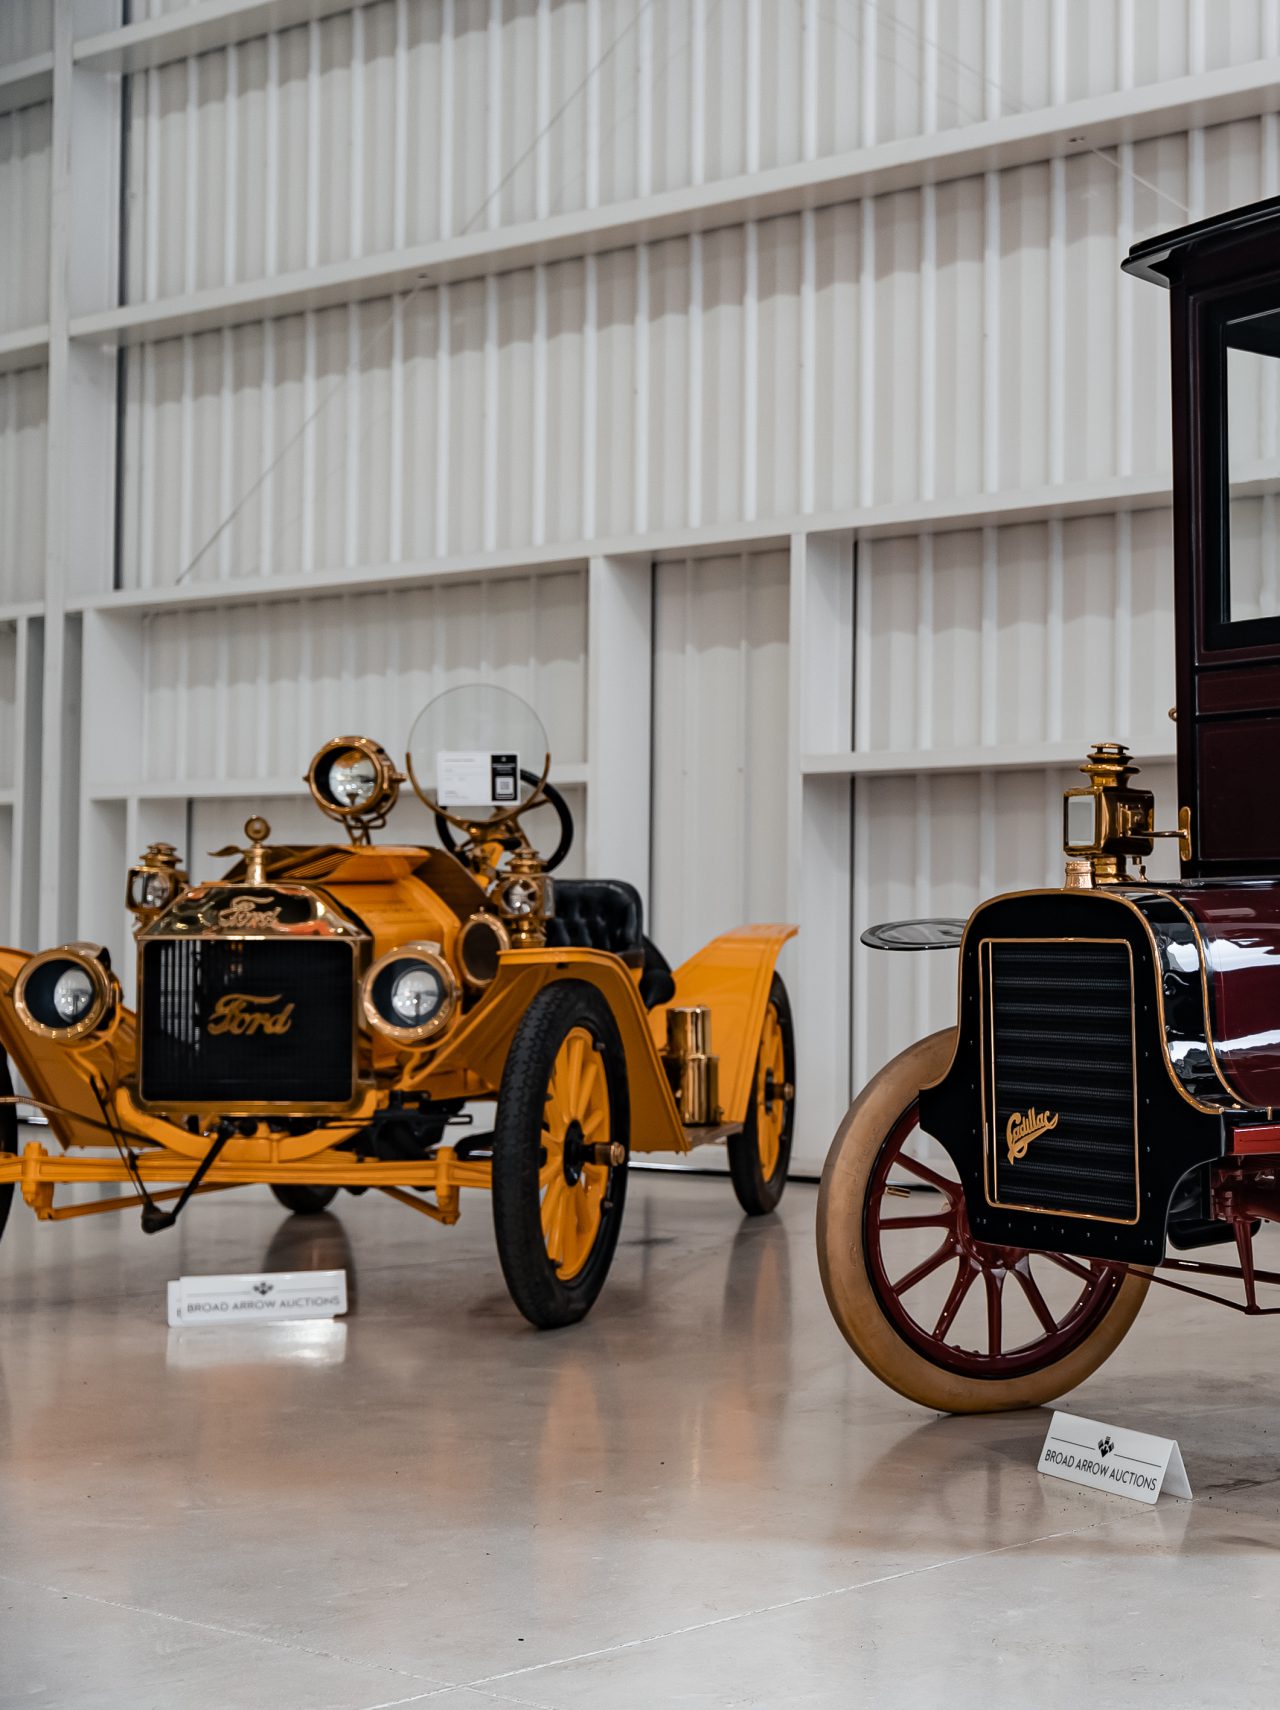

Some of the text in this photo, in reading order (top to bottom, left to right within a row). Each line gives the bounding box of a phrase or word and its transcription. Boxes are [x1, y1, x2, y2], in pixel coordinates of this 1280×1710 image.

[217, 895, 281, 928] Ford
[207, 993, 295, 1036] Ford
[1006, 1106, 1059, 1166] Cadillac
[187, 1302, 229, 1313] BROAD
[232, 1300, 276, 1310] ARROW
[279, 1295, 341, 1308] AUCTIONS
[1044, 1449, 1158, 1491] BROAD ARROW AUCTIONS
